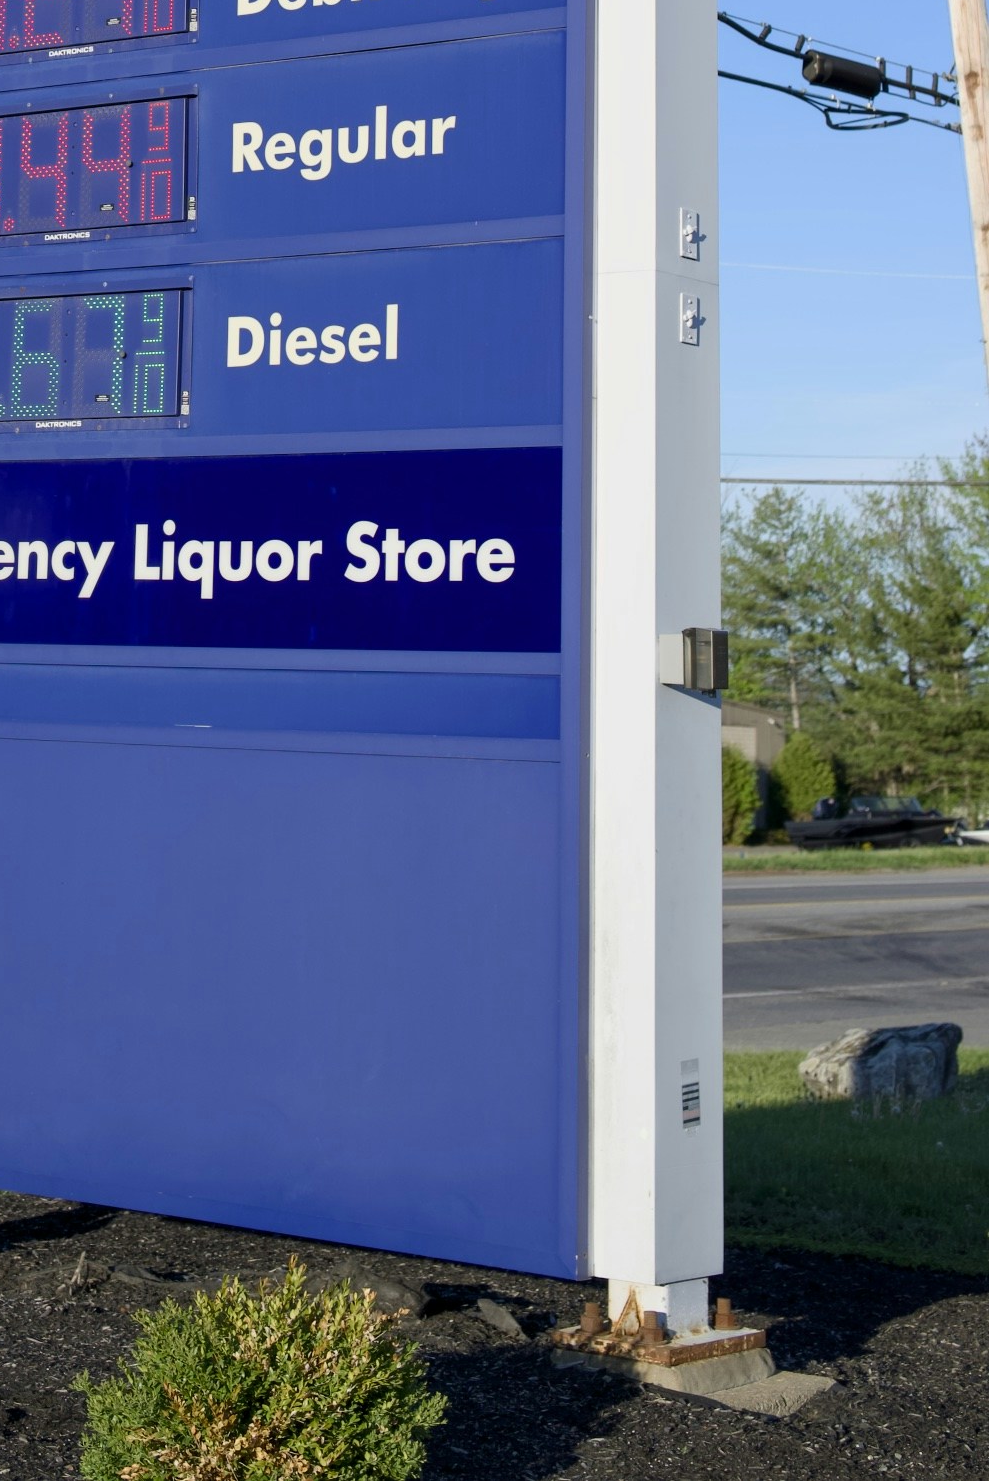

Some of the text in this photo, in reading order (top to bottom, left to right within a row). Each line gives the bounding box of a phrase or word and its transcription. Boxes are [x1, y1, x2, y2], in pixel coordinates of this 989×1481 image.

[48, 45, 94, 58] DAKTRONICS
[232, 105, 457, 181] Regular
[44, 231, 91, 242] DAKTRONICS
[226, 303, 399, 368] Diesel
[35, 420, 82, 430] DAKTRONICS
[134, 519, 323, 600] Liquor
[344, 520, 515, 583] Store
